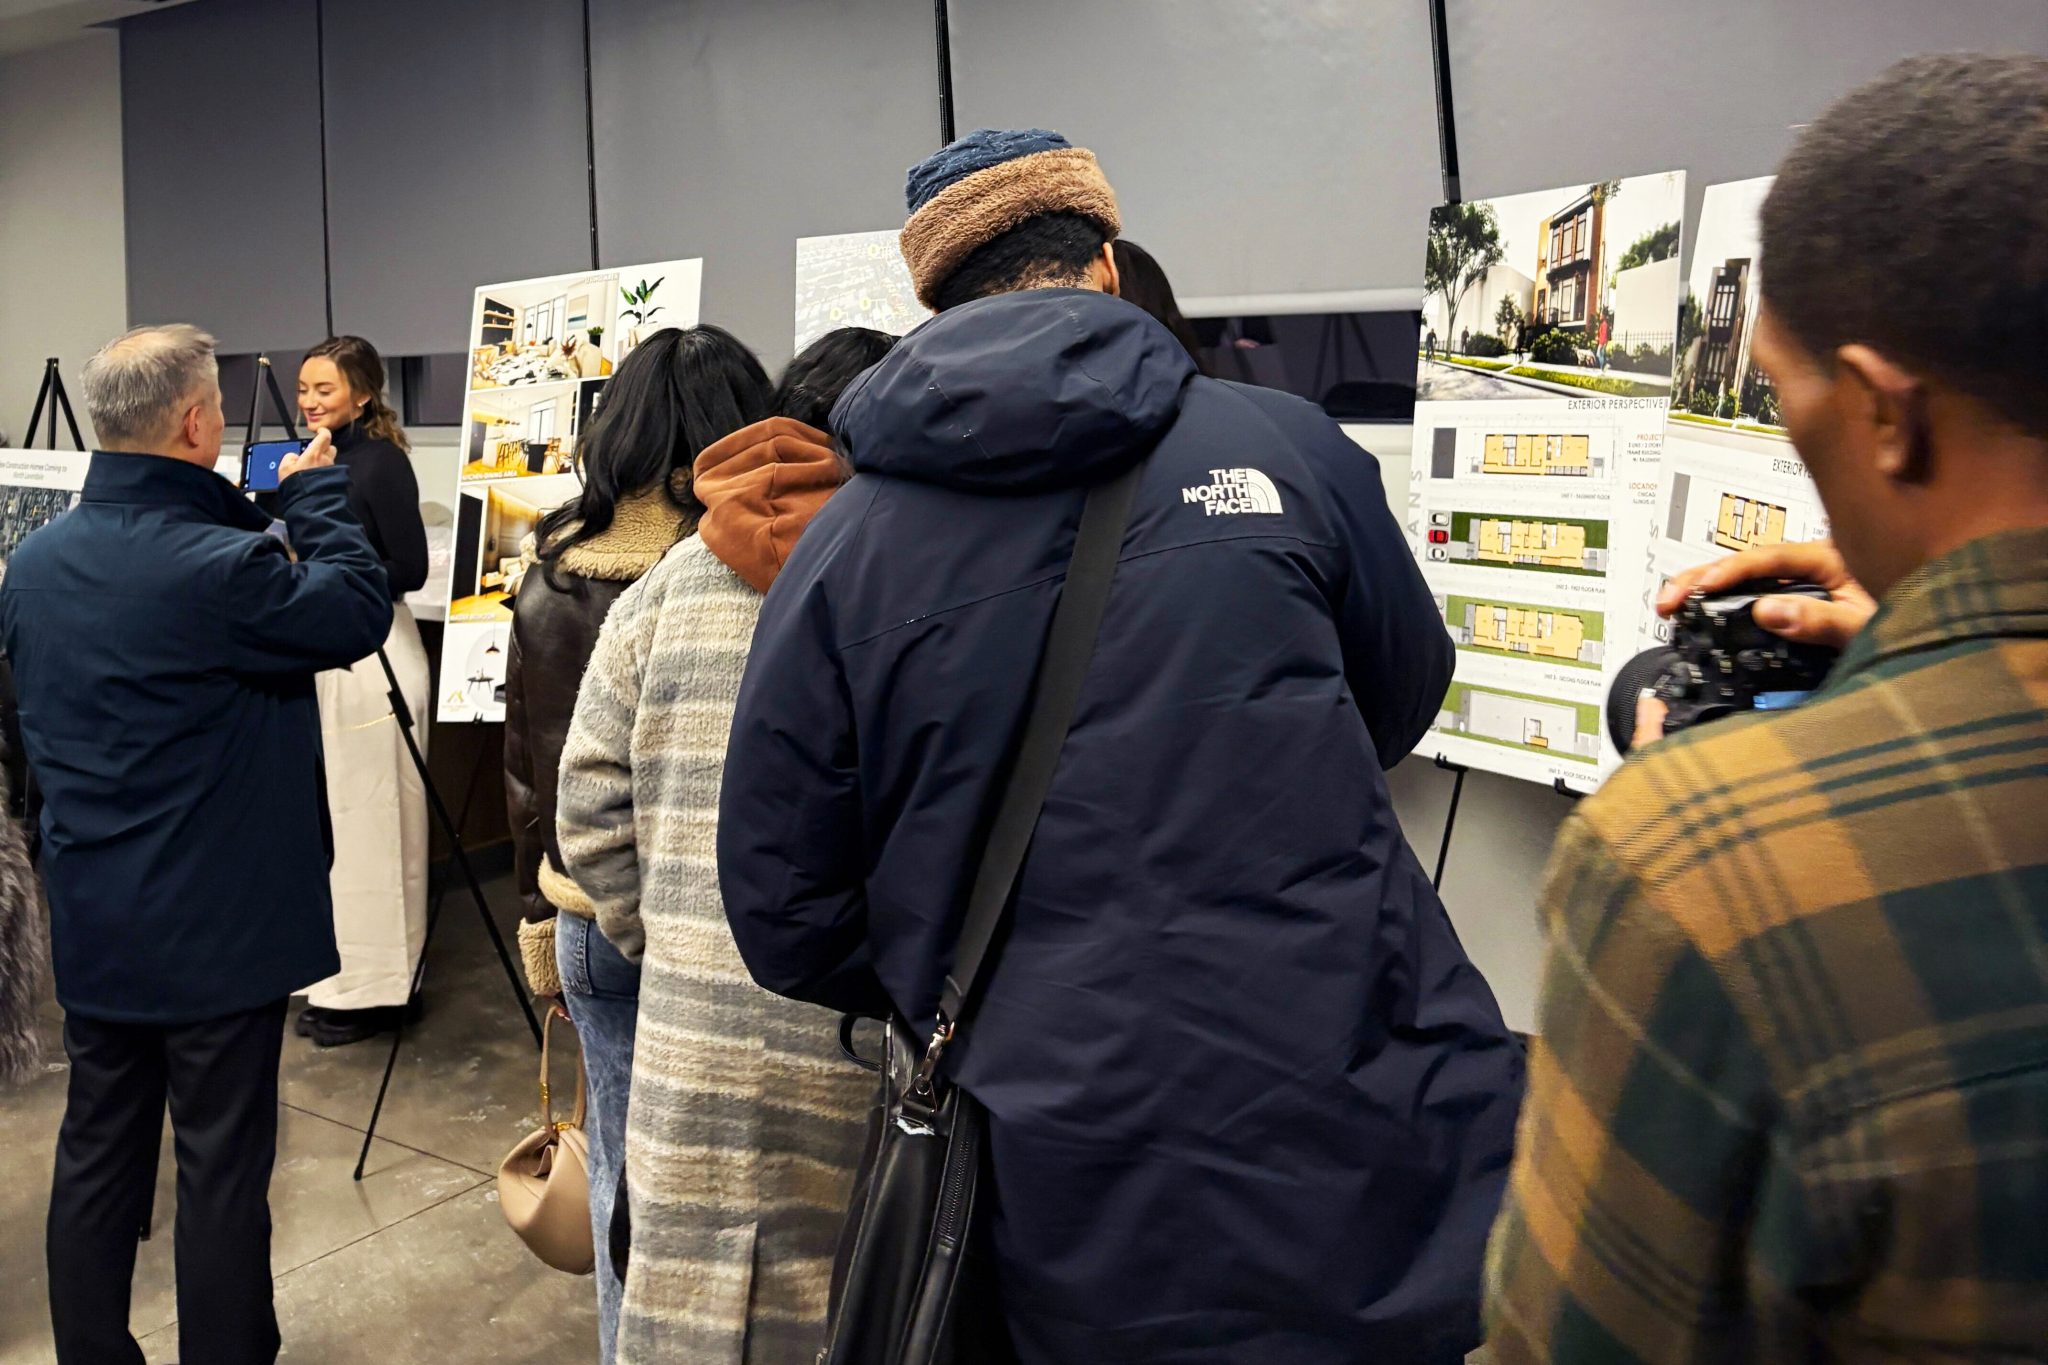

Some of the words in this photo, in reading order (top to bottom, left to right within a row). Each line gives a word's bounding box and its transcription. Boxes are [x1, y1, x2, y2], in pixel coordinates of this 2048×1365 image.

[1568, 399, 1607, 410] EXTERIOR
[1608, 398, 1663, 409] PERSPECTIVE
[1208, 468, 1247, 485] THE
[1182, 483, 1250, 504] NORTH
[1205, 497, 1252, 516] FACE
[1407, 470, 1422, 556] LANS
